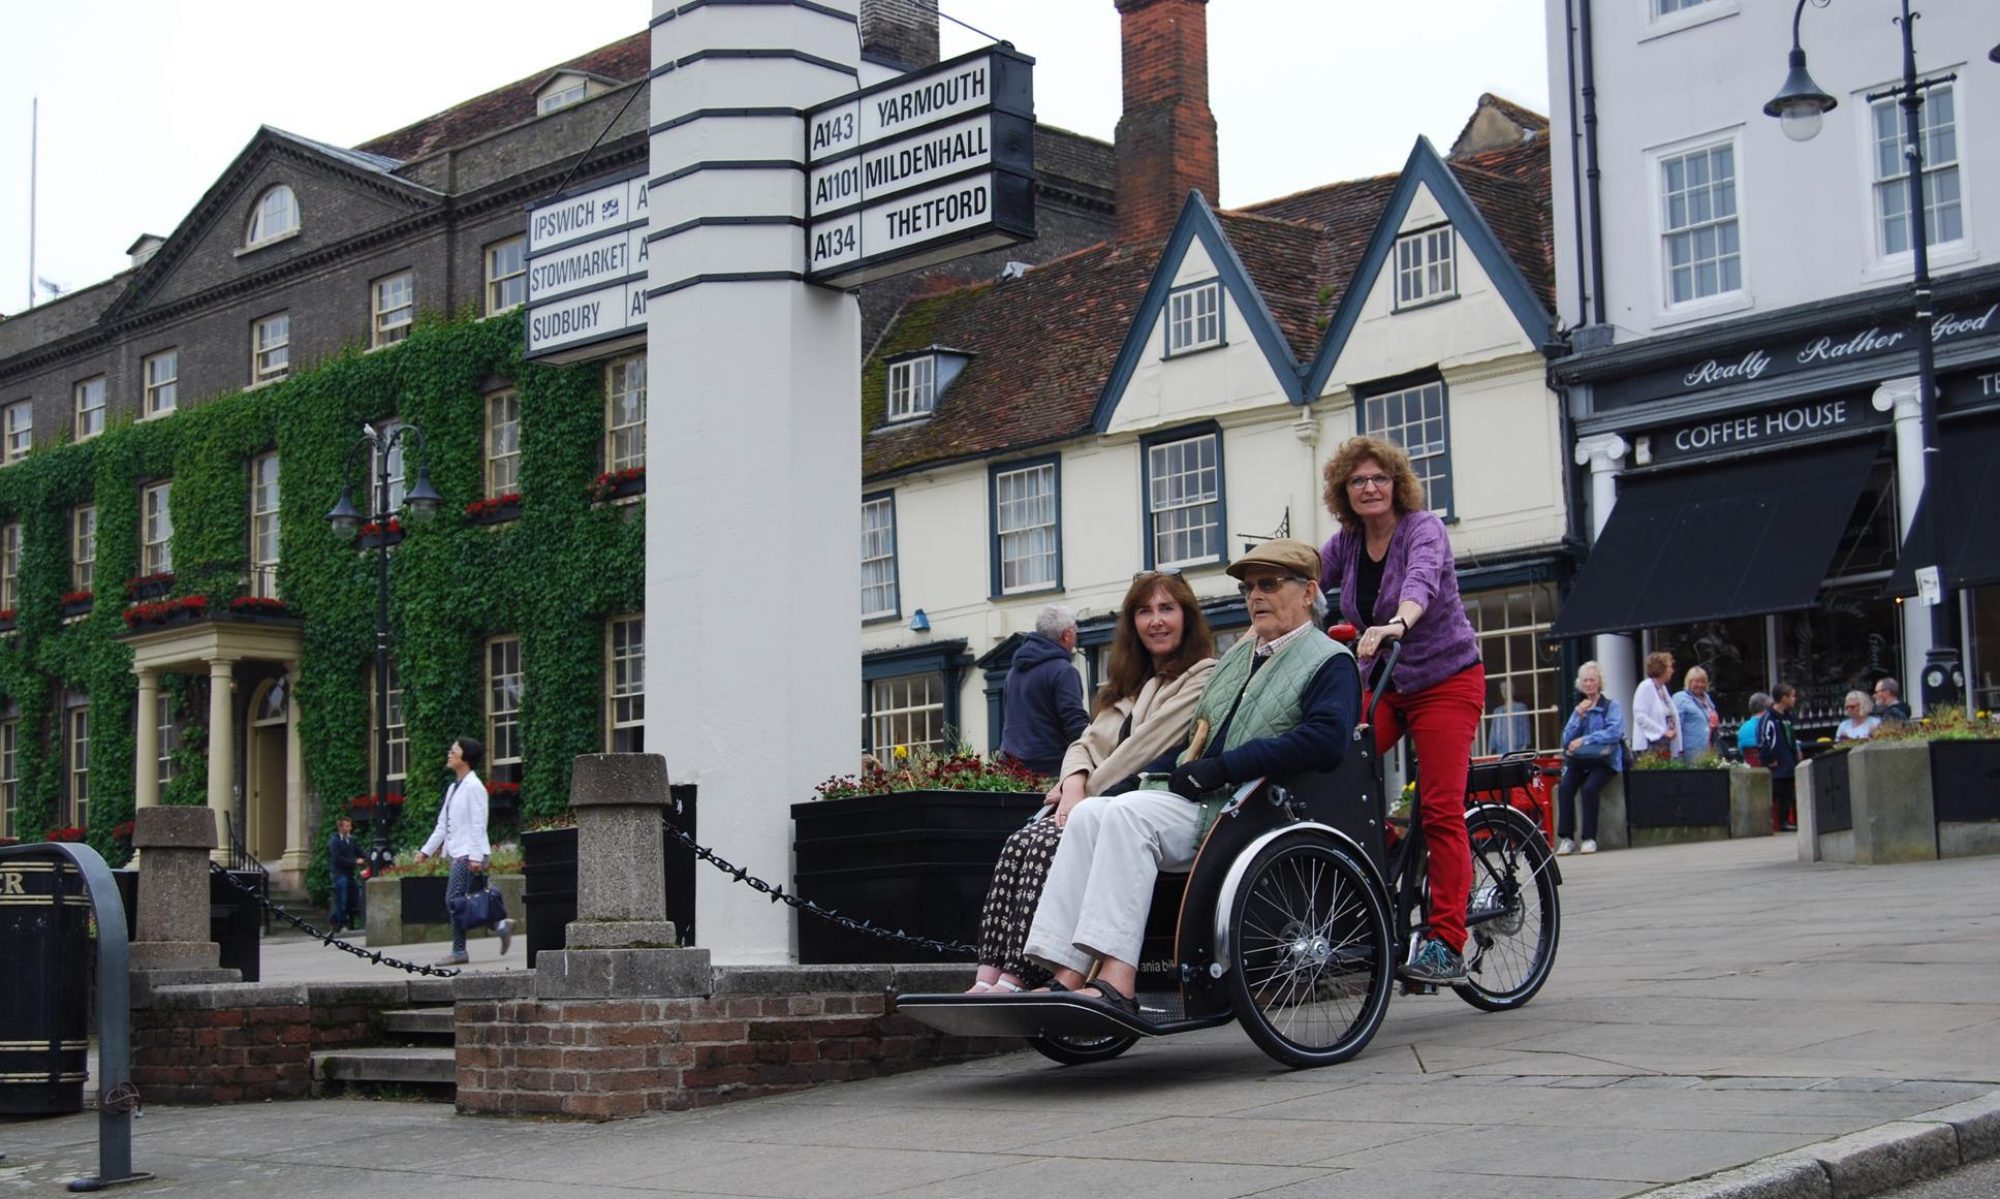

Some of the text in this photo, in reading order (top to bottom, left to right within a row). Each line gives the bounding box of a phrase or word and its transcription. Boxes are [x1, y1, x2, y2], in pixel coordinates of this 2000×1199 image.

[814, 67, 986, 151] A143 YARMOUTH
[815, 126, 988, 206] A1101 MILDENHALL
[534, 184, 650, 241] IPSWICH A
[814, 186, 987, 262] A134 THETFORD
[532, 237, 649, 292] STOWMARKET A
[533, 289, 647, 342] SUDBURY A1
[1684, 302, 2000, 386] Really Rather Good
[1675, 400, 1847, 451] COFFEE HOUSE
